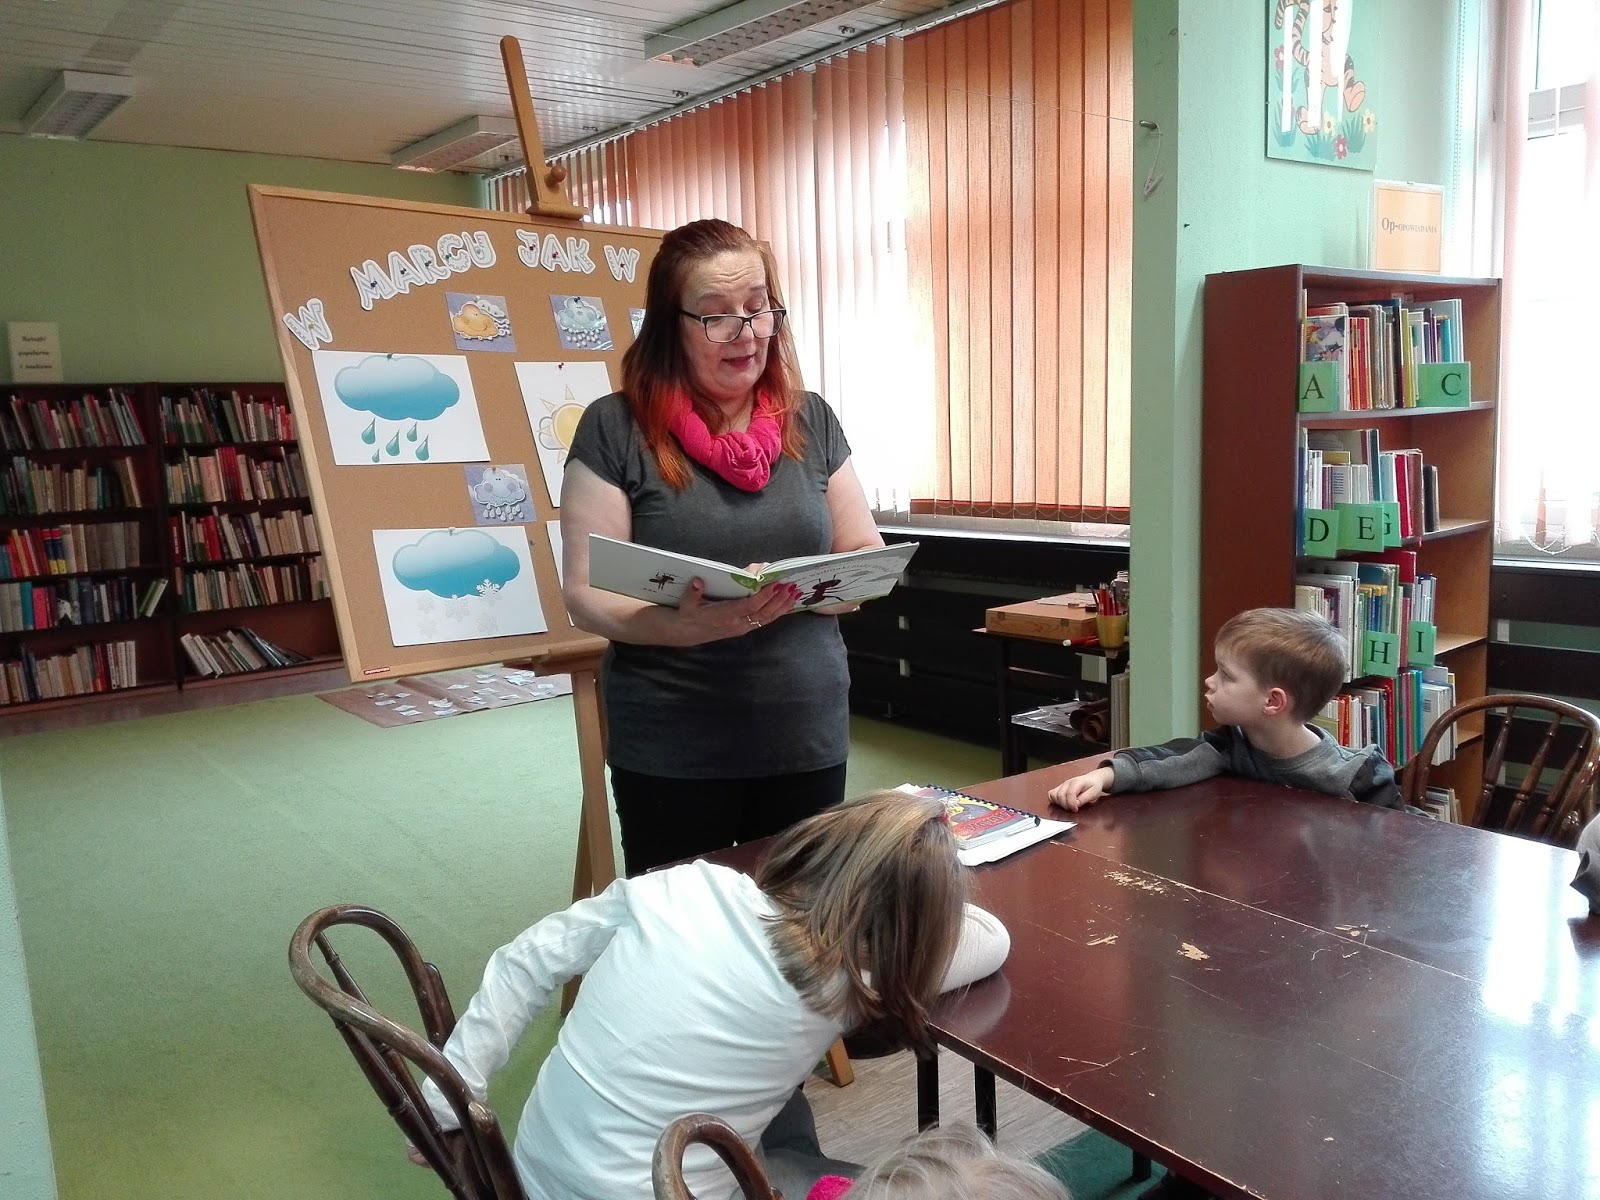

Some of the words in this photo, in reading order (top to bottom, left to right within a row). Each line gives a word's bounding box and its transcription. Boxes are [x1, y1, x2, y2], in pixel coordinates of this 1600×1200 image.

[283, 298, 333, 350] W
[350, 230, 497, 311] MARCU
[515, 228, 596, 274] JAK
[604, 244, 641, 283] W
[1302, 373, 1325, 400] A
[1441, 372, 1462, 397] C
[1307, 517, 1330, 542] D
[1357, 516, 1376, 540] E
[1368, 639, 1391, 665] H
[1415, 631, 1425, 653] I
